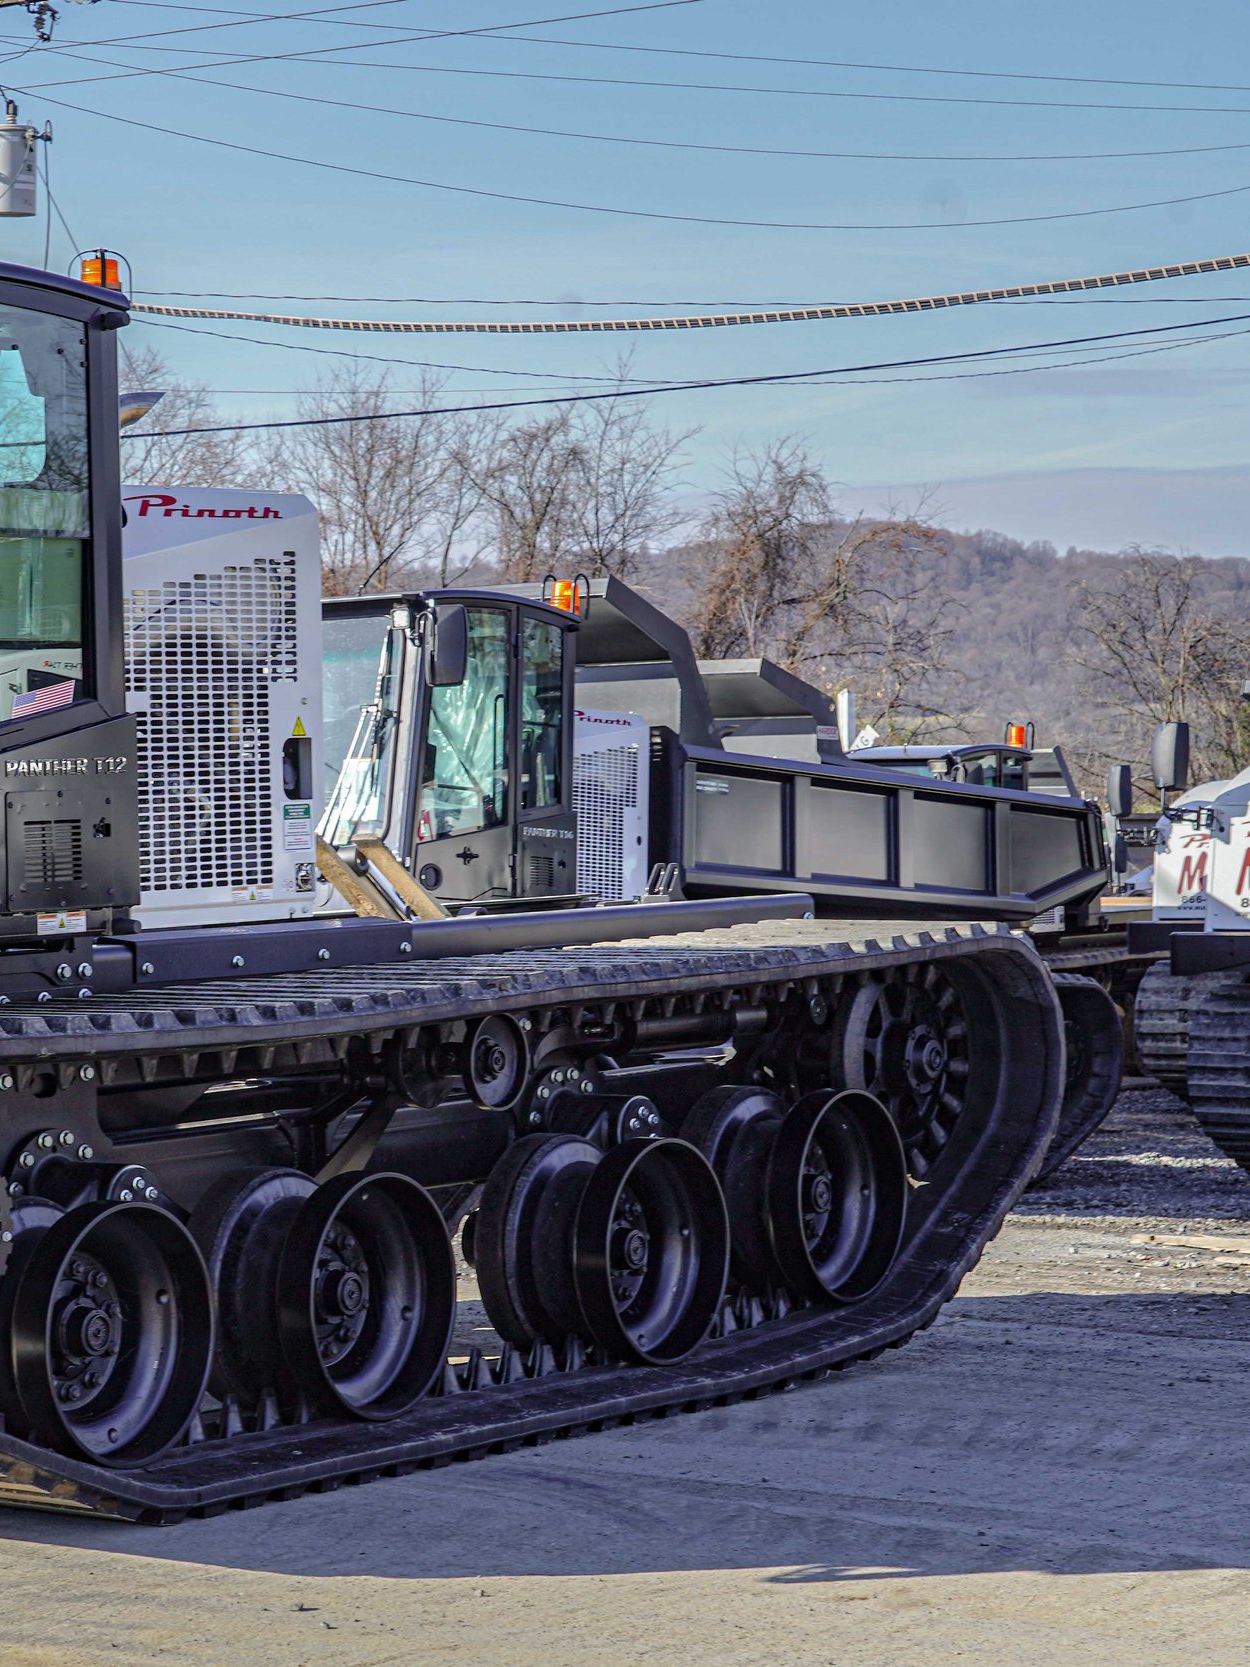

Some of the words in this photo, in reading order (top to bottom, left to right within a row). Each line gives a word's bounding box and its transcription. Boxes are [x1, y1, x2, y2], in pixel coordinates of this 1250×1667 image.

[123, 494, 283, 519] Prinoth
[6, 758, 89, 776] PANTHER
[94, 756, 128, 773] T12
